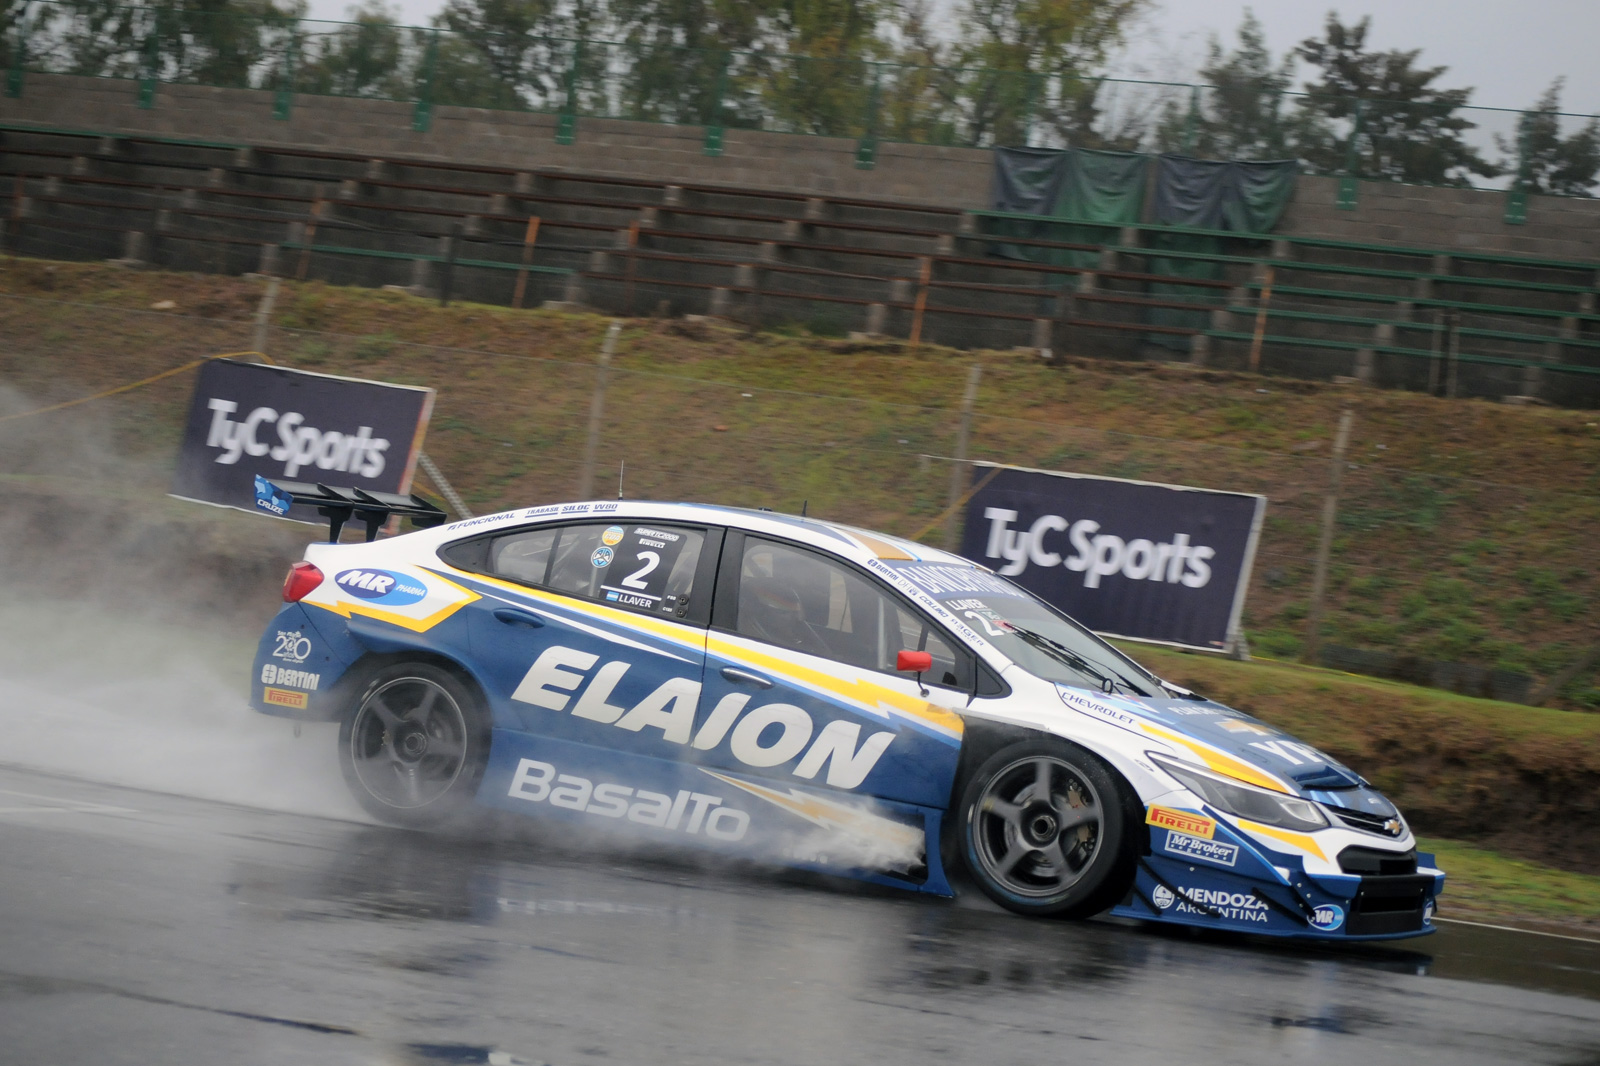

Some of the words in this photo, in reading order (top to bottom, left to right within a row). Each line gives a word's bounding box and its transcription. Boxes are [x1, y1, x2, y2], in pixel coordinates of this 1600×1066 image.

[207, 397, 278, 464] TyC
[269, 412, 391, 478] Sports
[257, 498, 284, 515] CRUZE
[456, 512, 515, 529] FUNCIONAL
[984, 507, 1069, 576] TyC
[1063, 519, 1215, 588] Sports
[338, 570, 395, 594] MR
[395, 584, 426, 597] PHARMA
[621, 551, 660, 590] 2
[618, 594, 652, 608] LLAVER
[964, 610, 1004, 637] 2
[276, 667, 320, 690] BERTINI
[268, 690, 303, 707] PIRELLI
[1061, 691, 1136, 725] CHEVROLET
[511, 645, 896, 789] ELAION
[1151, 808, 1211, 835] PIRELLI
[1171, 834, 1190, 846] Mr
[1189, 839, 1232, 857] Broker
